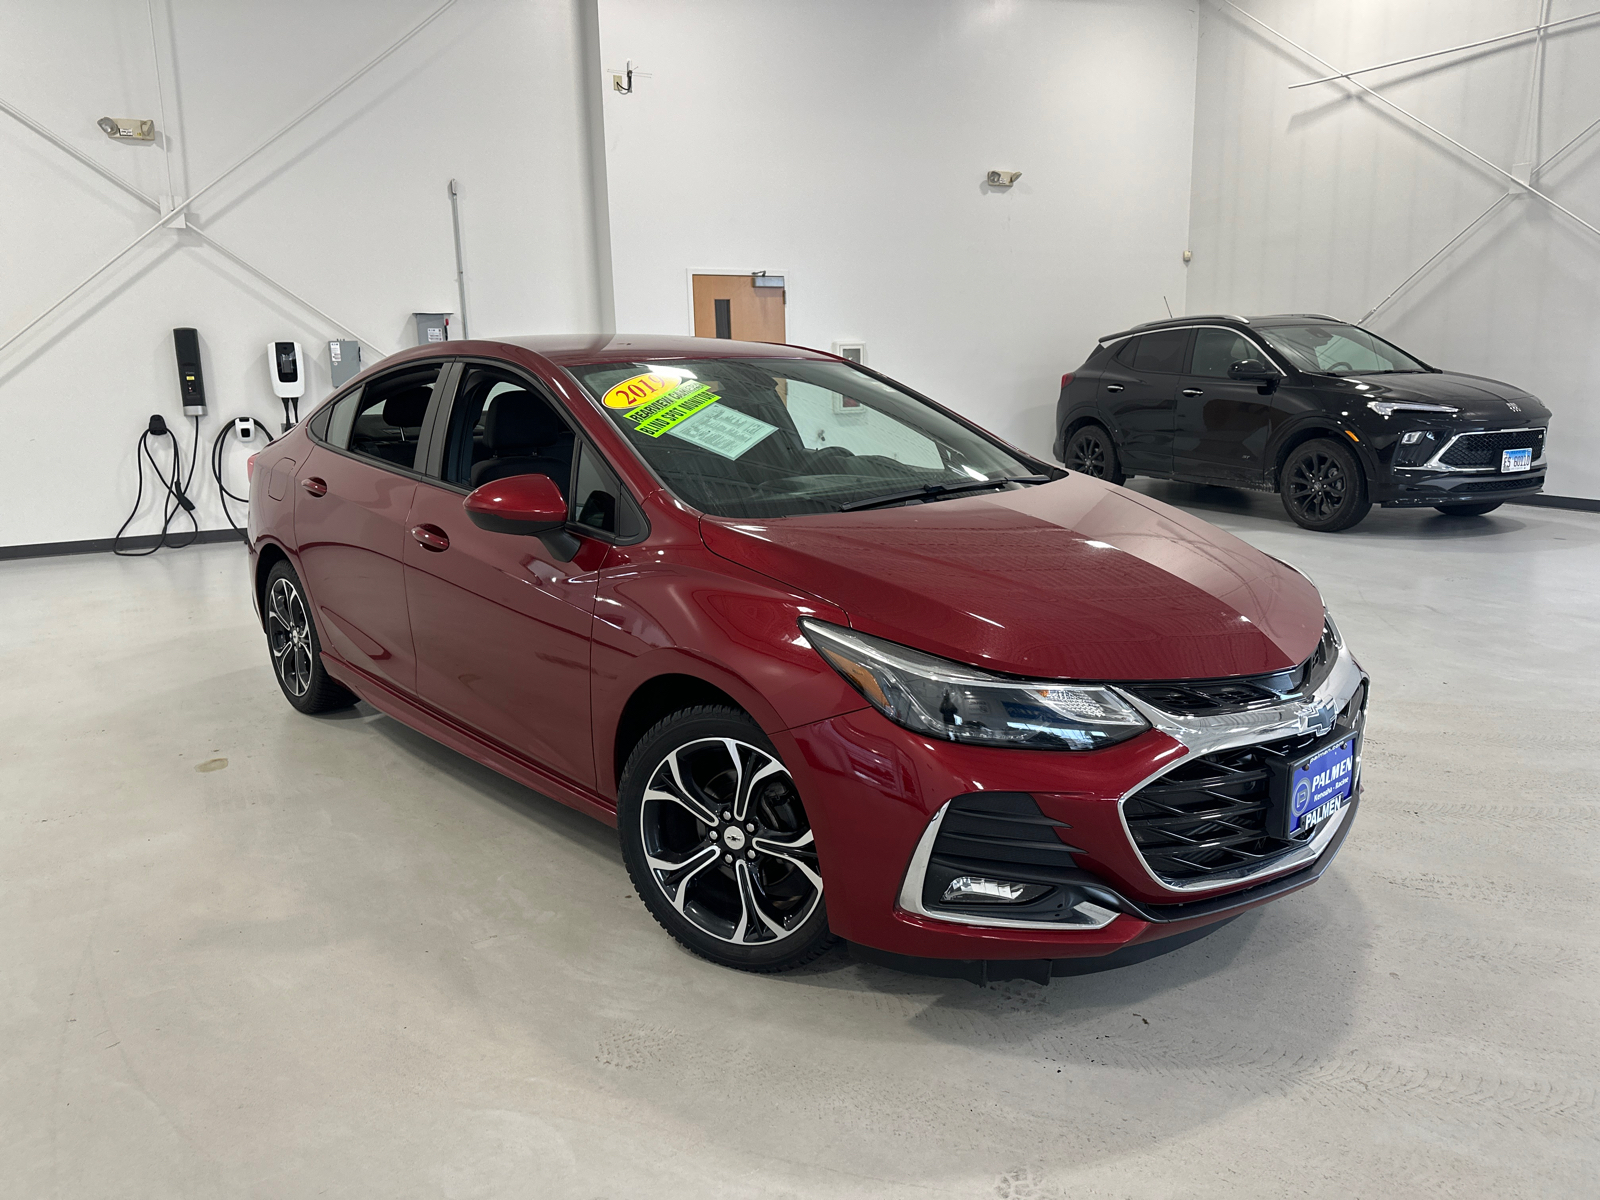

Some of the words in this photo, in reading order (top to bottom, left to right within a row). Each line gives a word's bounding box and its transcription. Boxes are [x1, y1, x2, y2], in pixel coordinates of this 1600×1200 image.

[615, 373, 665, 405] 2019
[629, 393, 674, 422] REARVIEW
[639, 418, 671, 436] BLIND
[660, 407, 687, 422] SPOT
[678, 390, 717, 412] MONITOR
[1311, 755, 1353, 793] PALMEN
[1313, 786, 1333, 802] Kenosha
[1335, 776, 1349, 790] Racine
[1305, 794, 1342, 831] PALMEN
